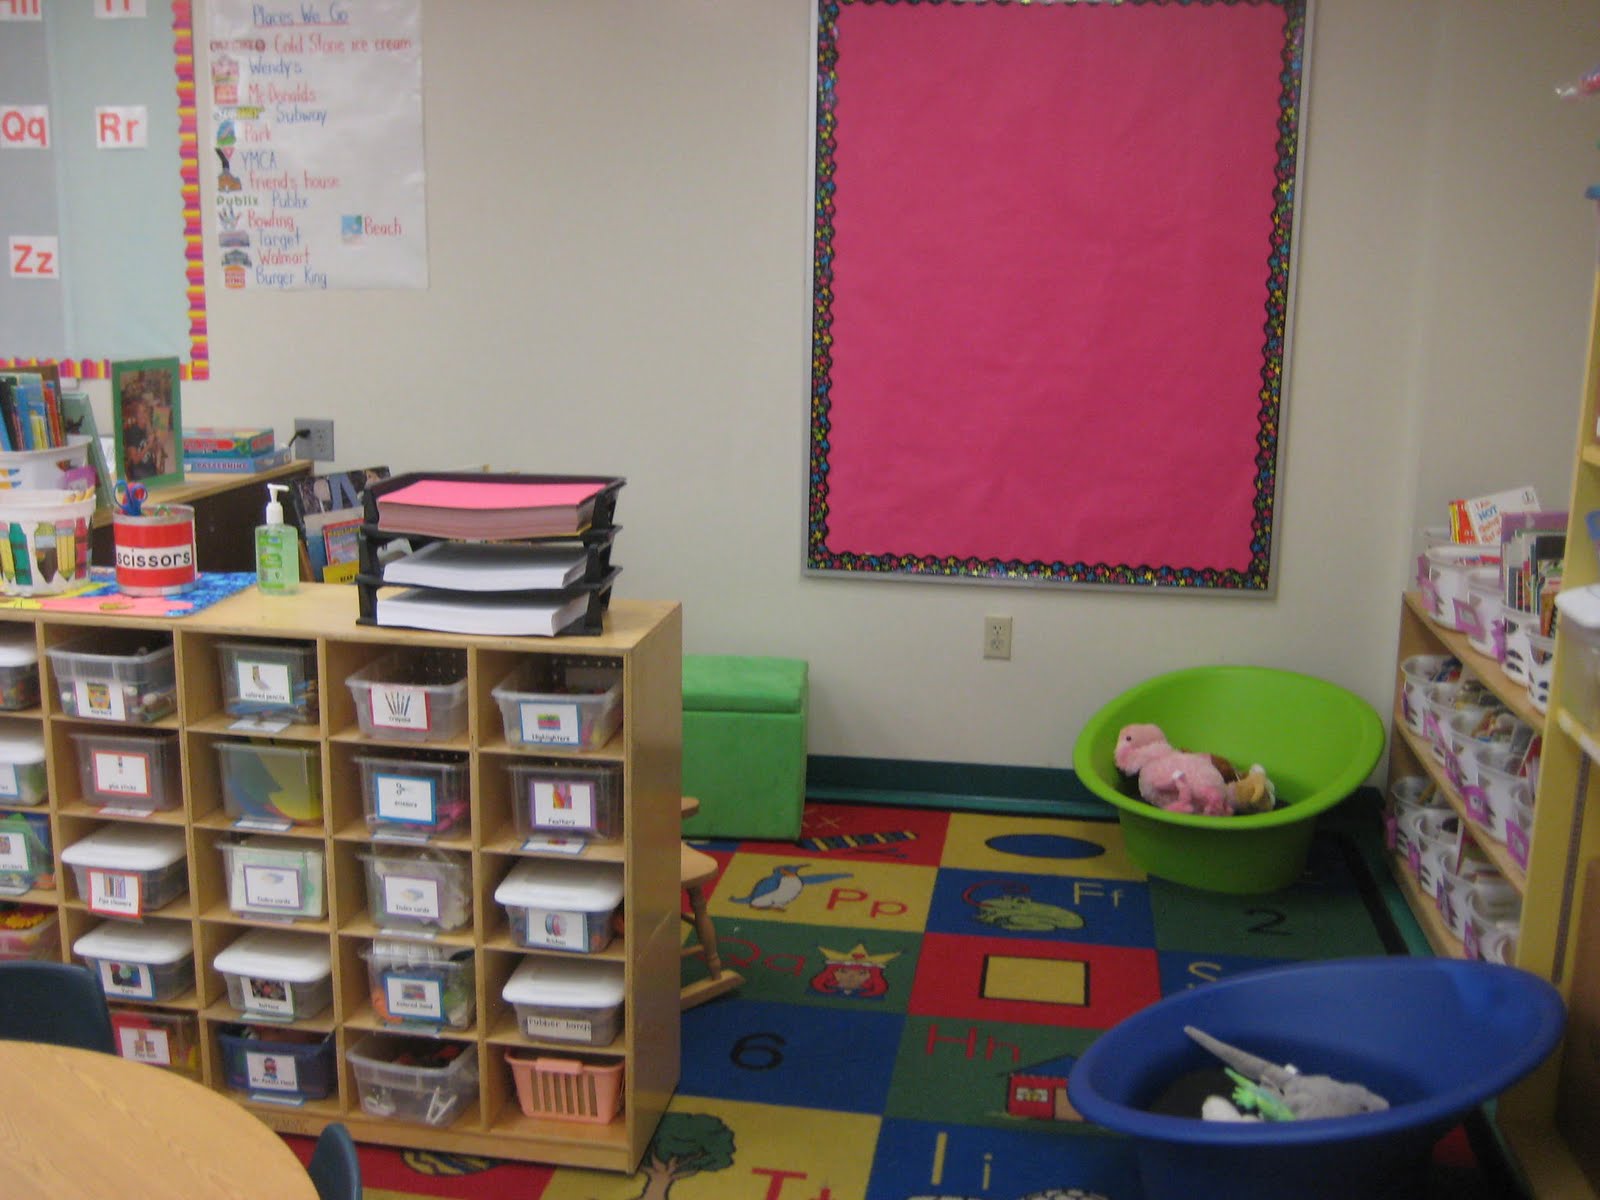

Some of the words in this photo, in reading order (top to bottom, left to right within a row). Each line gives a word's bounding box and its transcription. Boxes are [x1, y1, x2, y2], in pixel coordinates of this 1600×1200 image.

[253, 5, 294, 26] Places
[301, 4, 321, 23] We
[329, 3, 349, 24] Go
[274, 32, 304, 54] Cold
[308, 32, 345, 54] Stone
[374, 37, 412, 50] cream
[276, 102, 327, 125] Subway
[1, 110, 48, 147] Qq
[98, 112, 139, 142] Rr
[244, 123, 272, 142] Park
[240, 150, 278, 169] YMCA
[303, 168, 341, 189] house
[272, 191, 310, 209] Publix
[247, 209, 295, 232] Bowling
[363, 216, 403, 236] Beach
[258, 227, 302, 250] Target
[13, 244, 54, 274] Zz
[257, 247, 311, 266] Walmart
[255, 266, 294, 288] Burger
[303, 264, 328, 290] King
[1478, 505, 1498, 521] NOT
[117, 547, 191, 568] scissors
[825, 887, 909, 918] Pp
[1243, 907, 1293, 937] 2
[729, 1032, 787, 1071] 6
